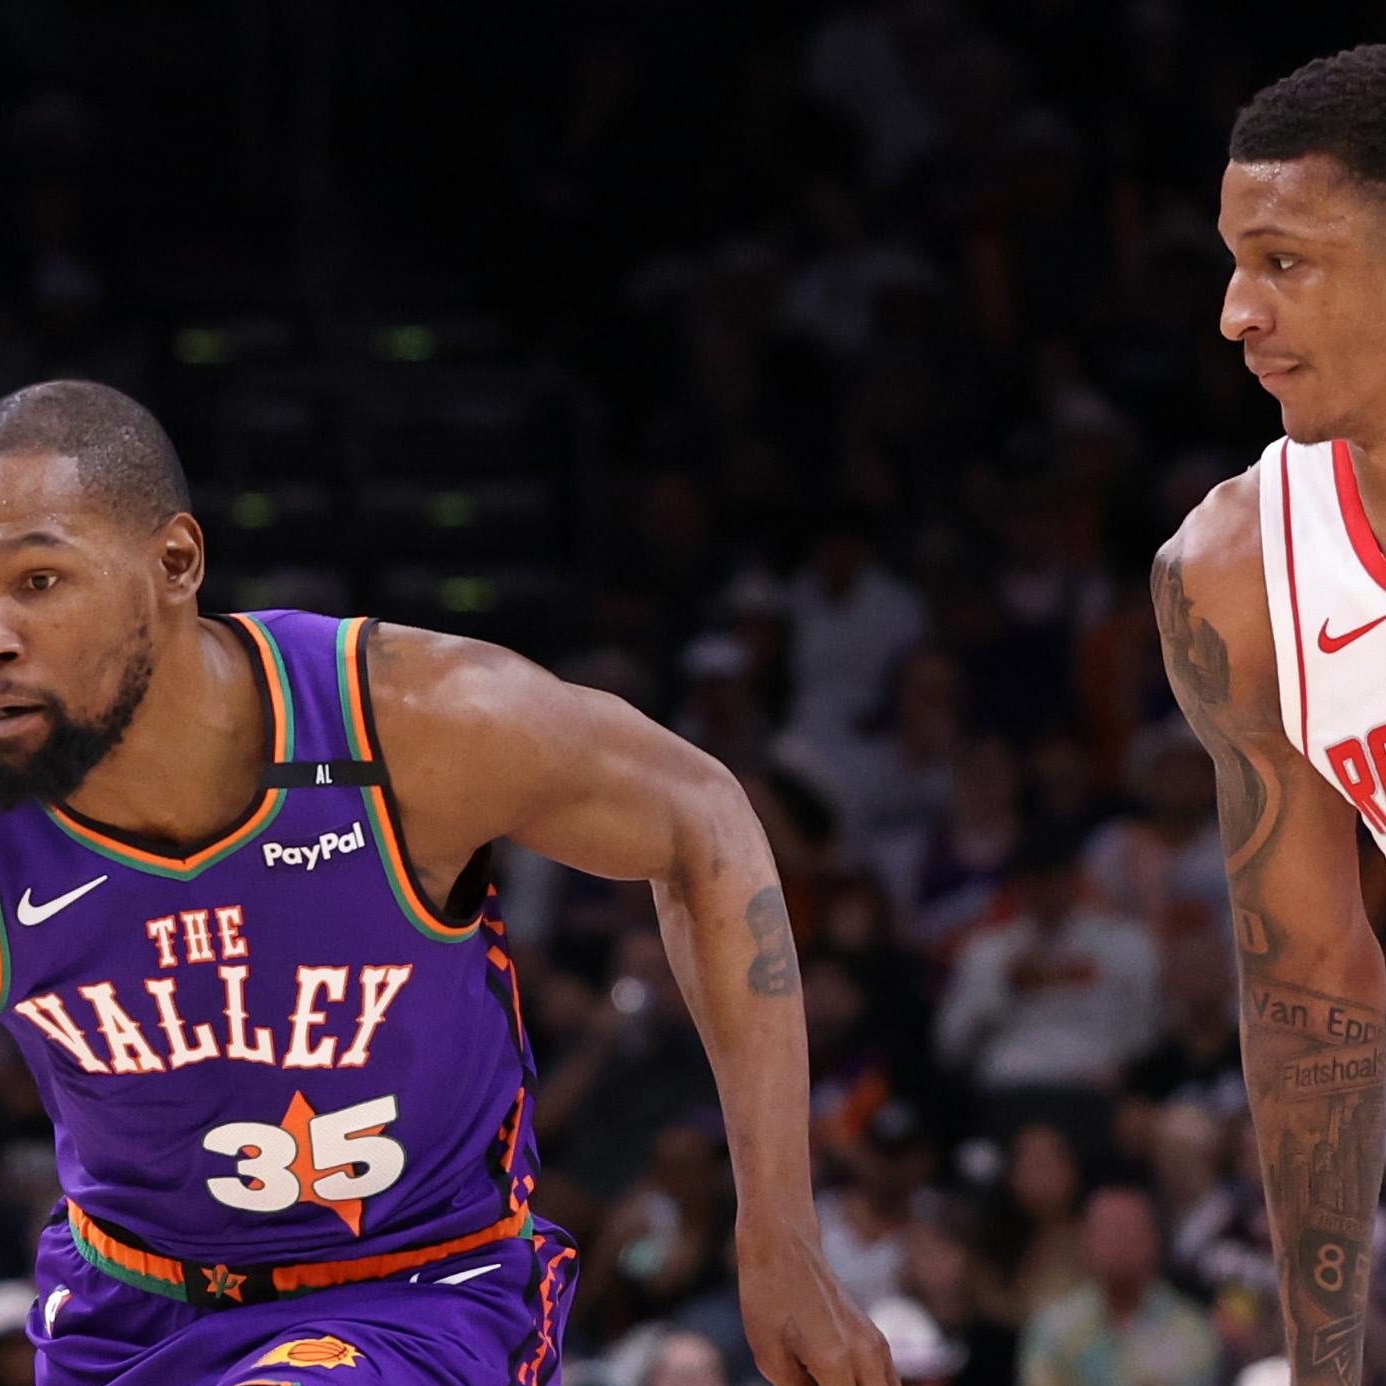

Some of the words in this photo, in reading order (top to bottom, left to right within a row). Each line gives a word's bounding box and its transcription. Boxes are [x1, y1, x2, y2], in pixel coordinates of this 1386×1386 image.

[315, 764, 333, 785] AL
[262, 821, 366, 871] PayPal
[146, 905, 248, 968] THE
[15, 964, 412, 1075] VALLEY
[1251, 988, 1309, 1028] Van
[1327, 1006, 1384, 1046] Epp
[1283, 1047, 1383, 1088] Flatshoal
[203, 1094, 406, 1213] 35
